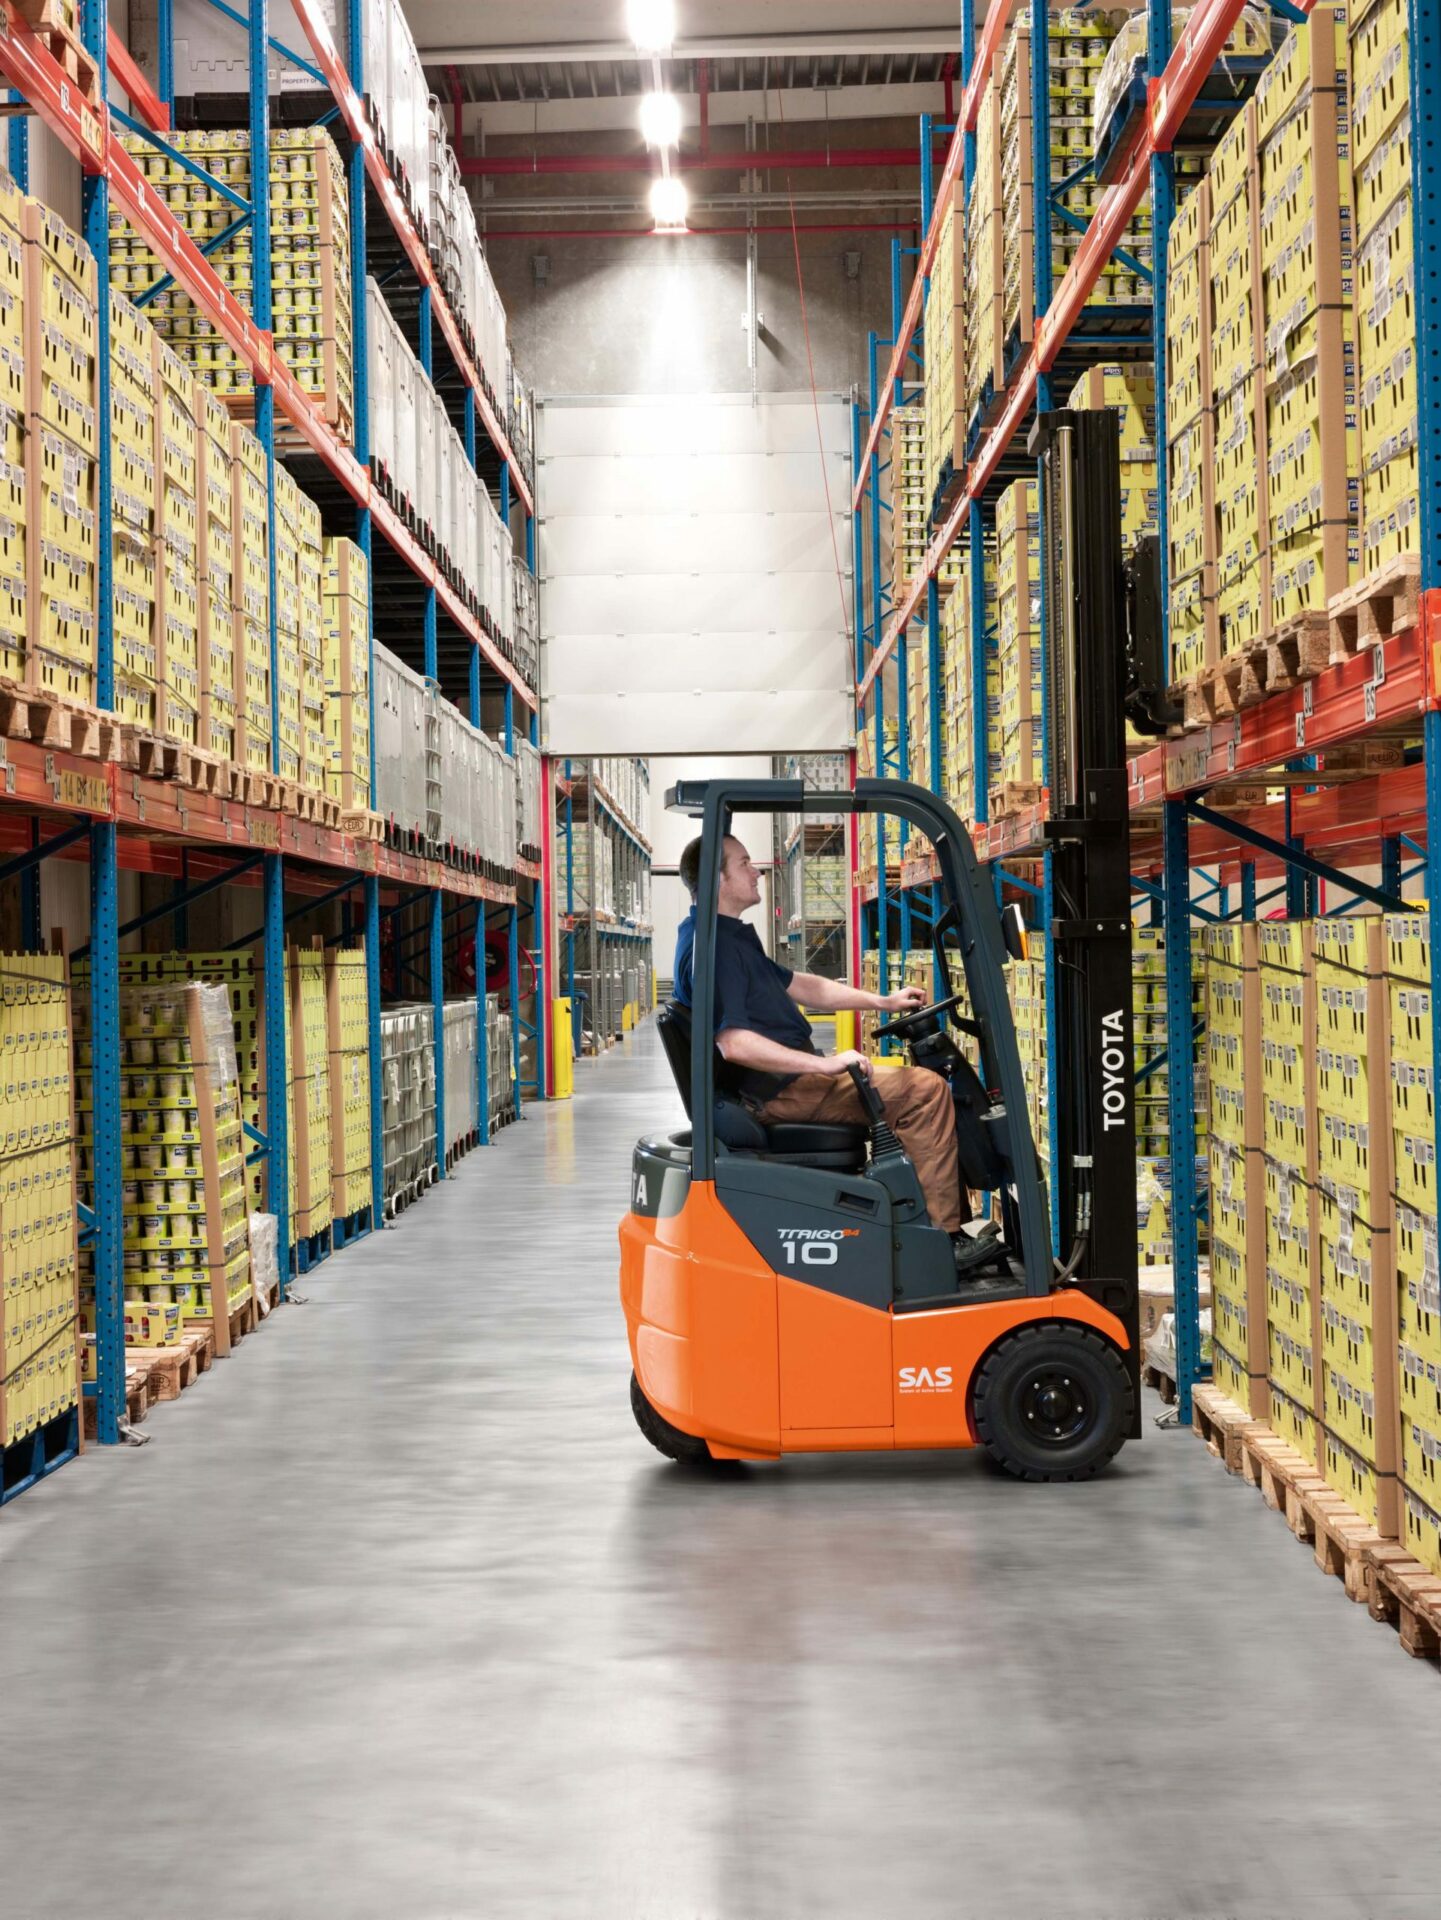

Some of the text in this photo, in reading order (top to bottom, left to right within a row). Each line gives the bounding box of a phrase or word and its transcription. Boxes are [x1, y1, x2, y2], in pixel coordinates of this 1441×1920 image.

[1102, 1009, 1126, 1131] TOYOTA
[782, 1242, 838, 1264] 10
[899, 1367, 952, 1387] SAS
